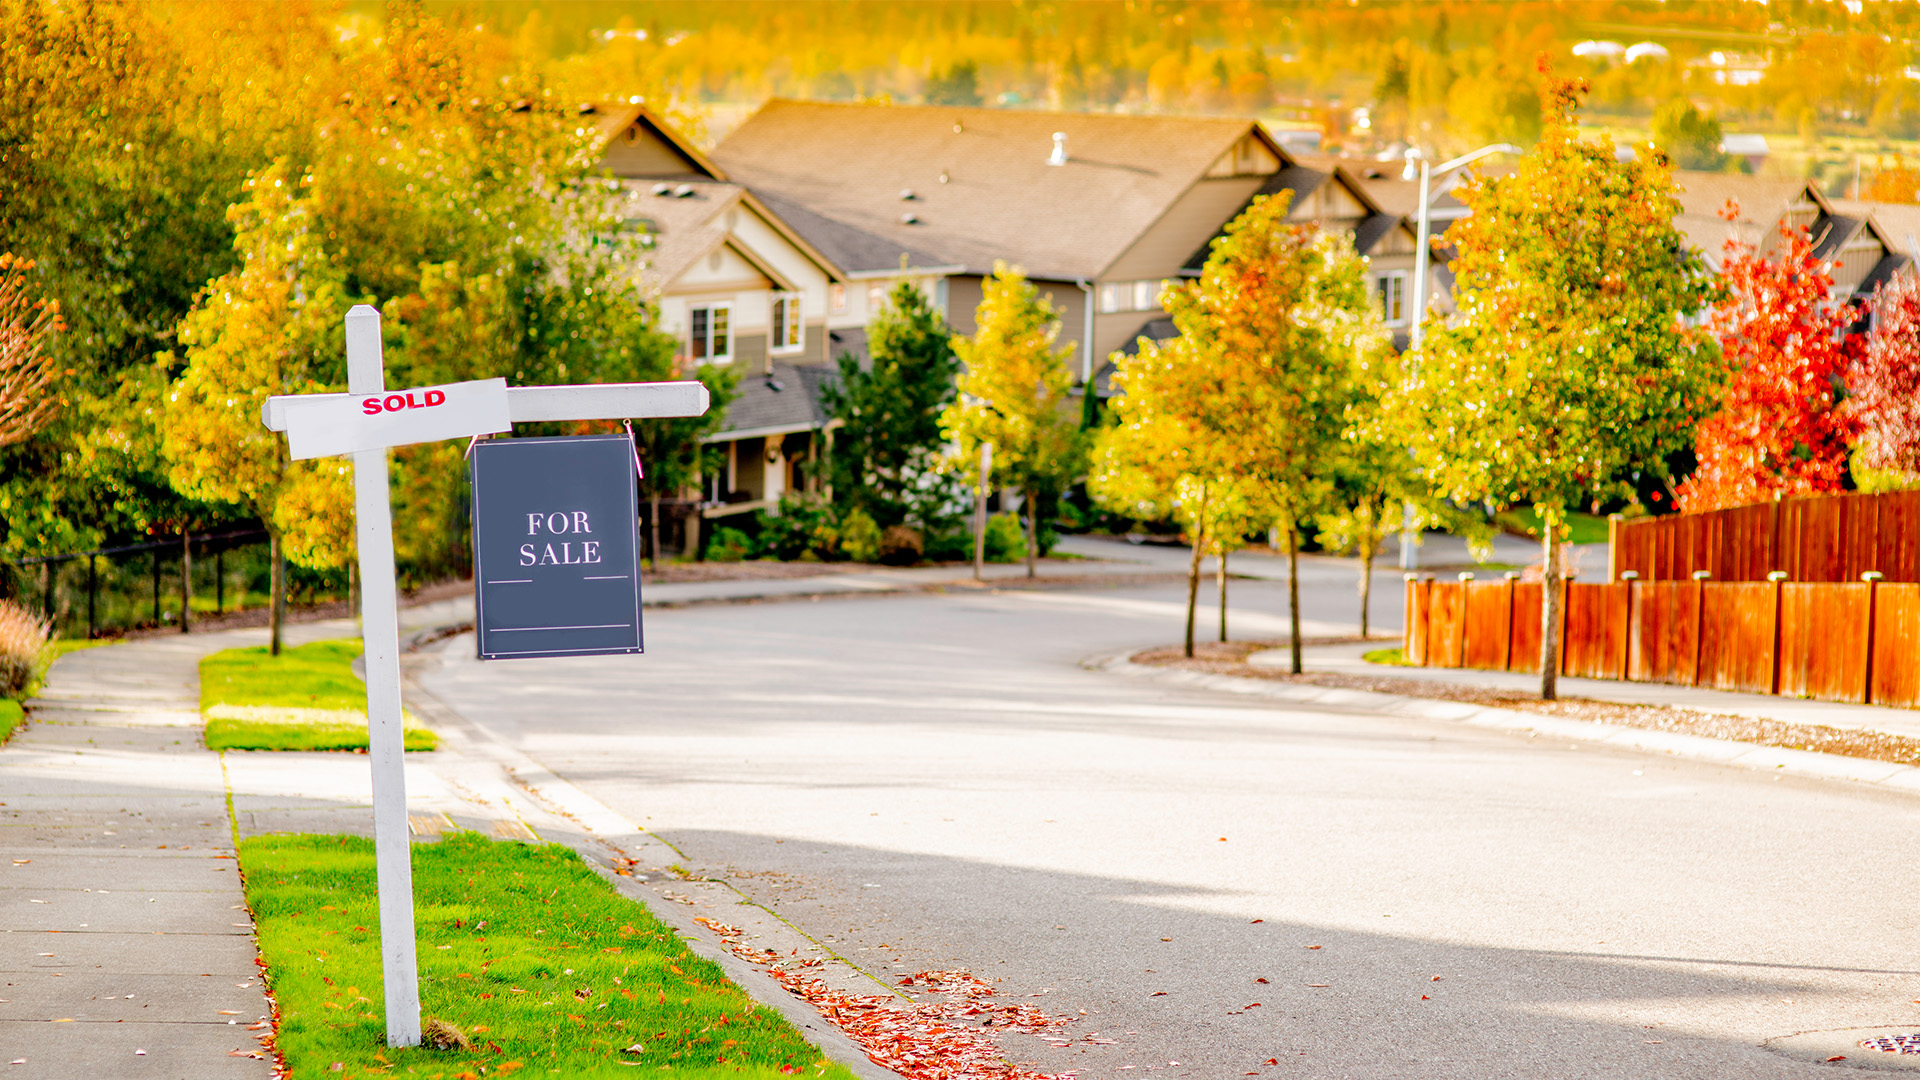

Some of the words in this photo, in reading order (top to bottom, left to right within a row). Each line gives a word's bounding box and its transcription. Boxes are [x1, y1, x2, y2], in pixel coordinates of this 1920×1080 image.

[362, 389, 446, 415] SOLD
[526, 511, 592, 536] FOR
[519, 541, 602, 567] SALE
